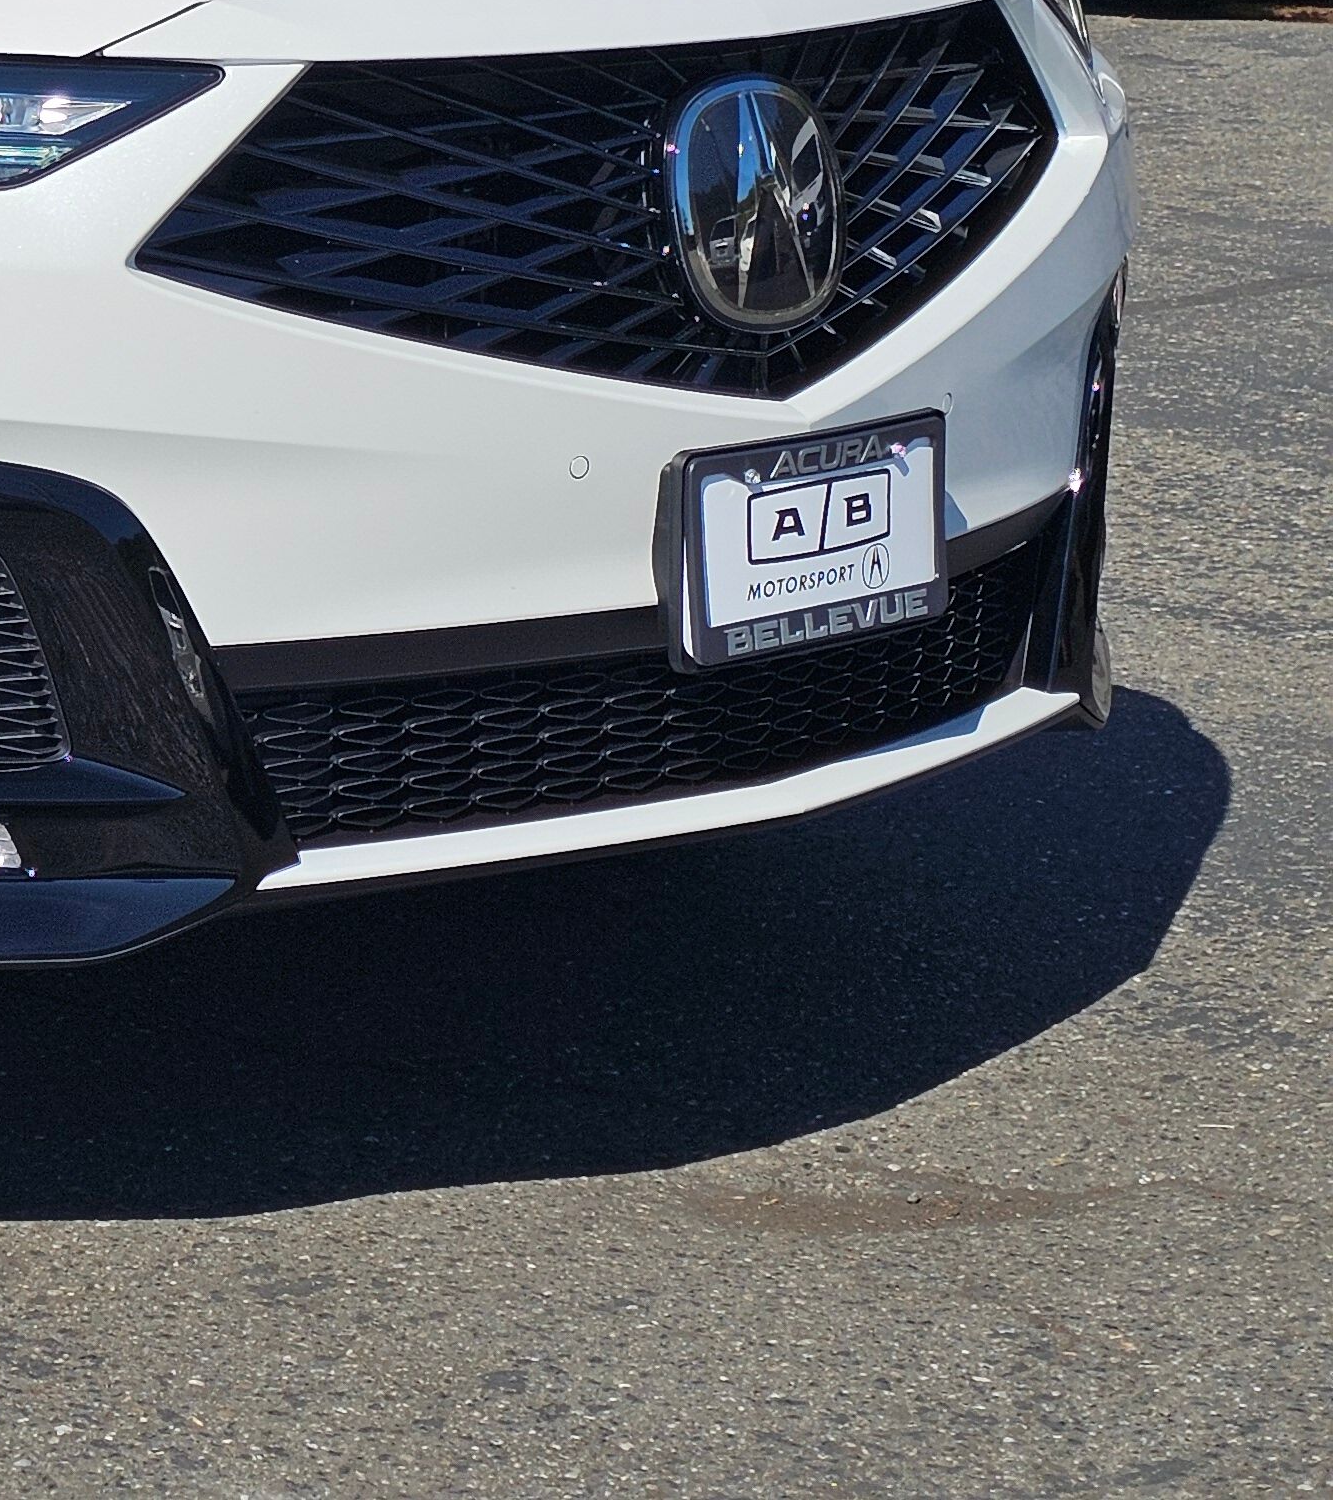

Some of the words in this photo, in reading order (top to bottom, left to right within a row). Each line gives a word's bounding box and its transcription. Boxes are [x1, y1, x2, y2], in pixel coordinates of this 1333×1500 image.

[769, 435, 884, 480] ACURA
[771, 507, 805, 541] A
[843, 493, 872, 527] B
[746, 563, 854, 601] MOTORSPORT
[723, 588, 929, 656] BELLEVUE
